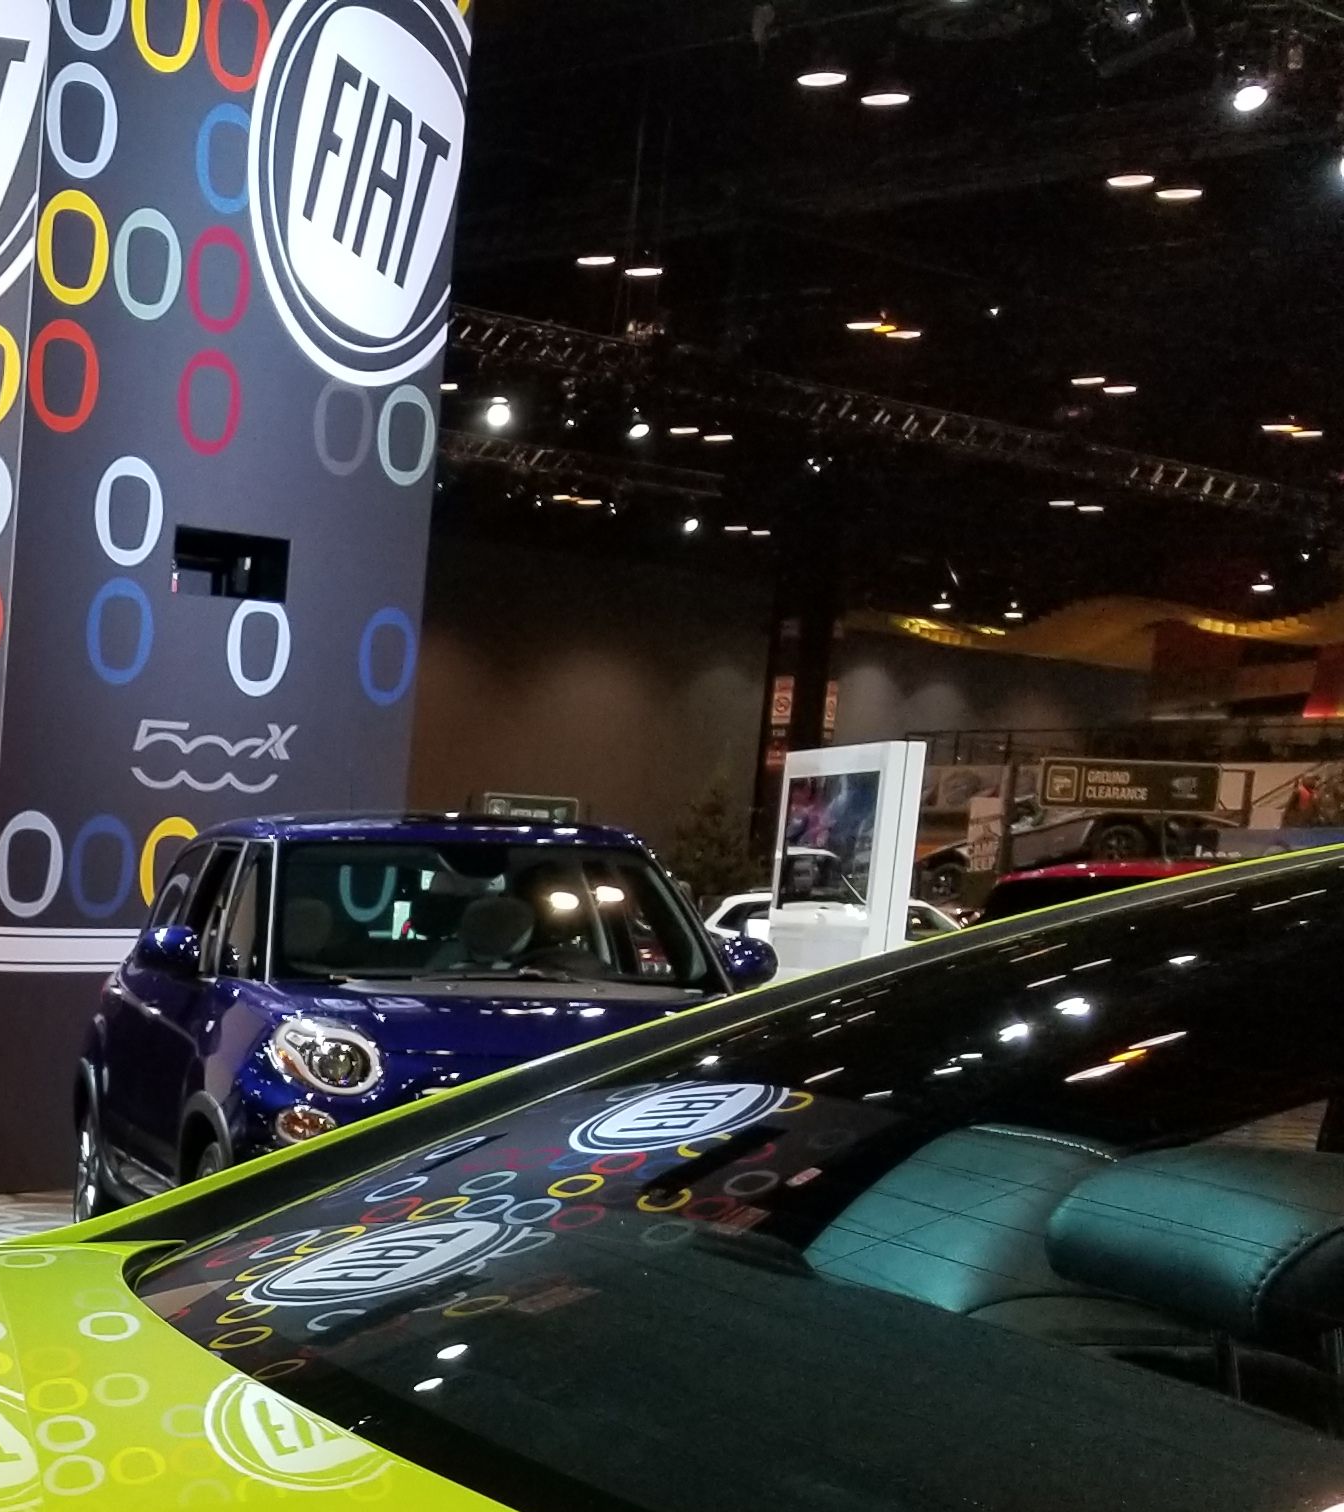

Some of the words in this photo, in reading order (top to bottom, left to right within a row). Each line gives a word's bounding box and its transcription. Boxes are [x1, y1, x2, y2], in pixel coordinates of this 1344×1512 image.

[303, 53, 451, 290] FIAT
[1087, 770, 1130, 784] GROUND
[1085, 785, 1149, 801] CLEARANCE
